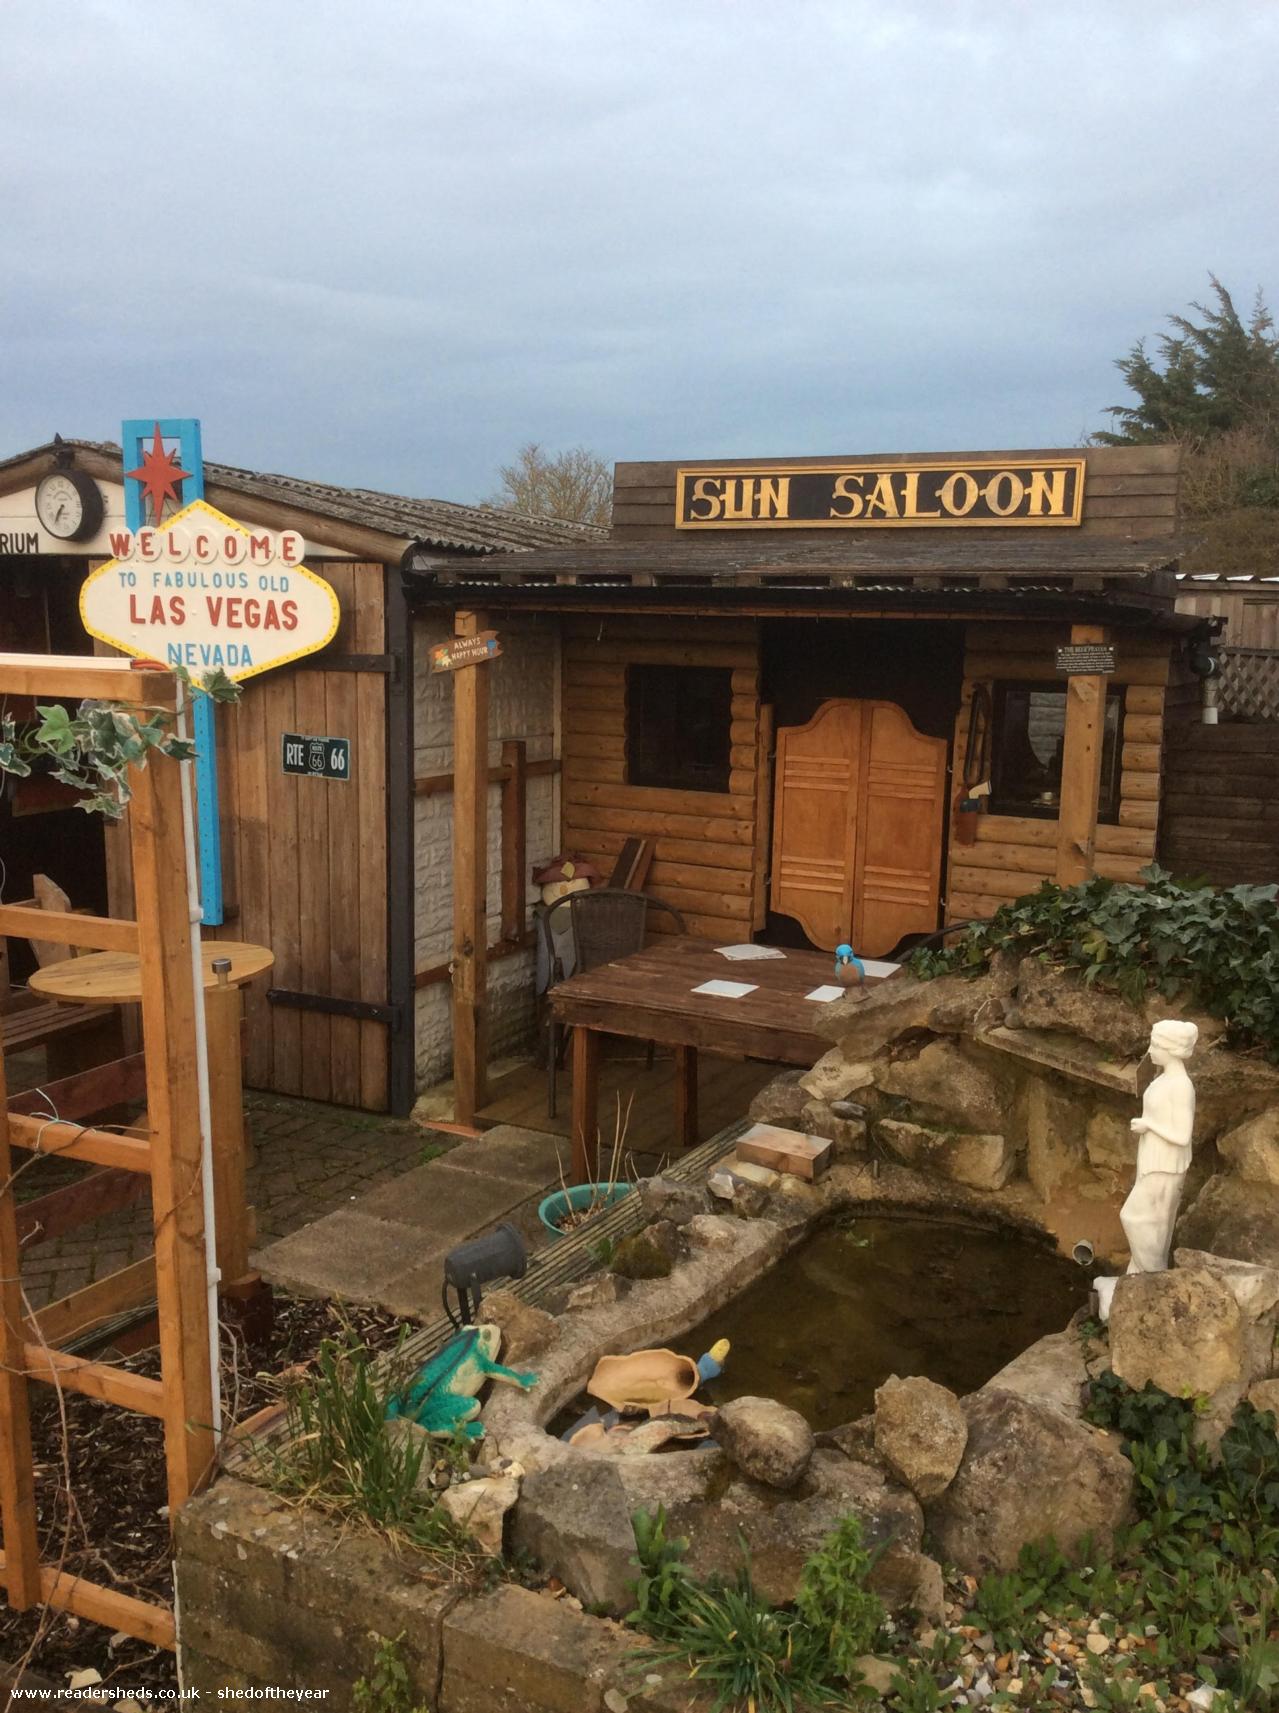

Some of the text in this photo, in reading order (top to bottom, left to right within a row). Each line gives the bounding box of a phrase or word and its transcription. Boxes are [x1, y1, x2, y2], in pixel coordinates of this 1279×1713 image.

[690, 471, 1069, 519] SUN SALOON
[109, 532, 296, 561] WELCOME
[118, 572, 289, 593] TO FABULOUS OLD
[129, 594, 298, 631] LAS VEGAS
[167, 643, 253, 666] NEVADA
[454, 637, 480, 649] ALWAYS
[451, 649, 470, 661] HAPPY
[286, 743, 345, 771] RTE 66
[312, 754, 322, 767] 66
